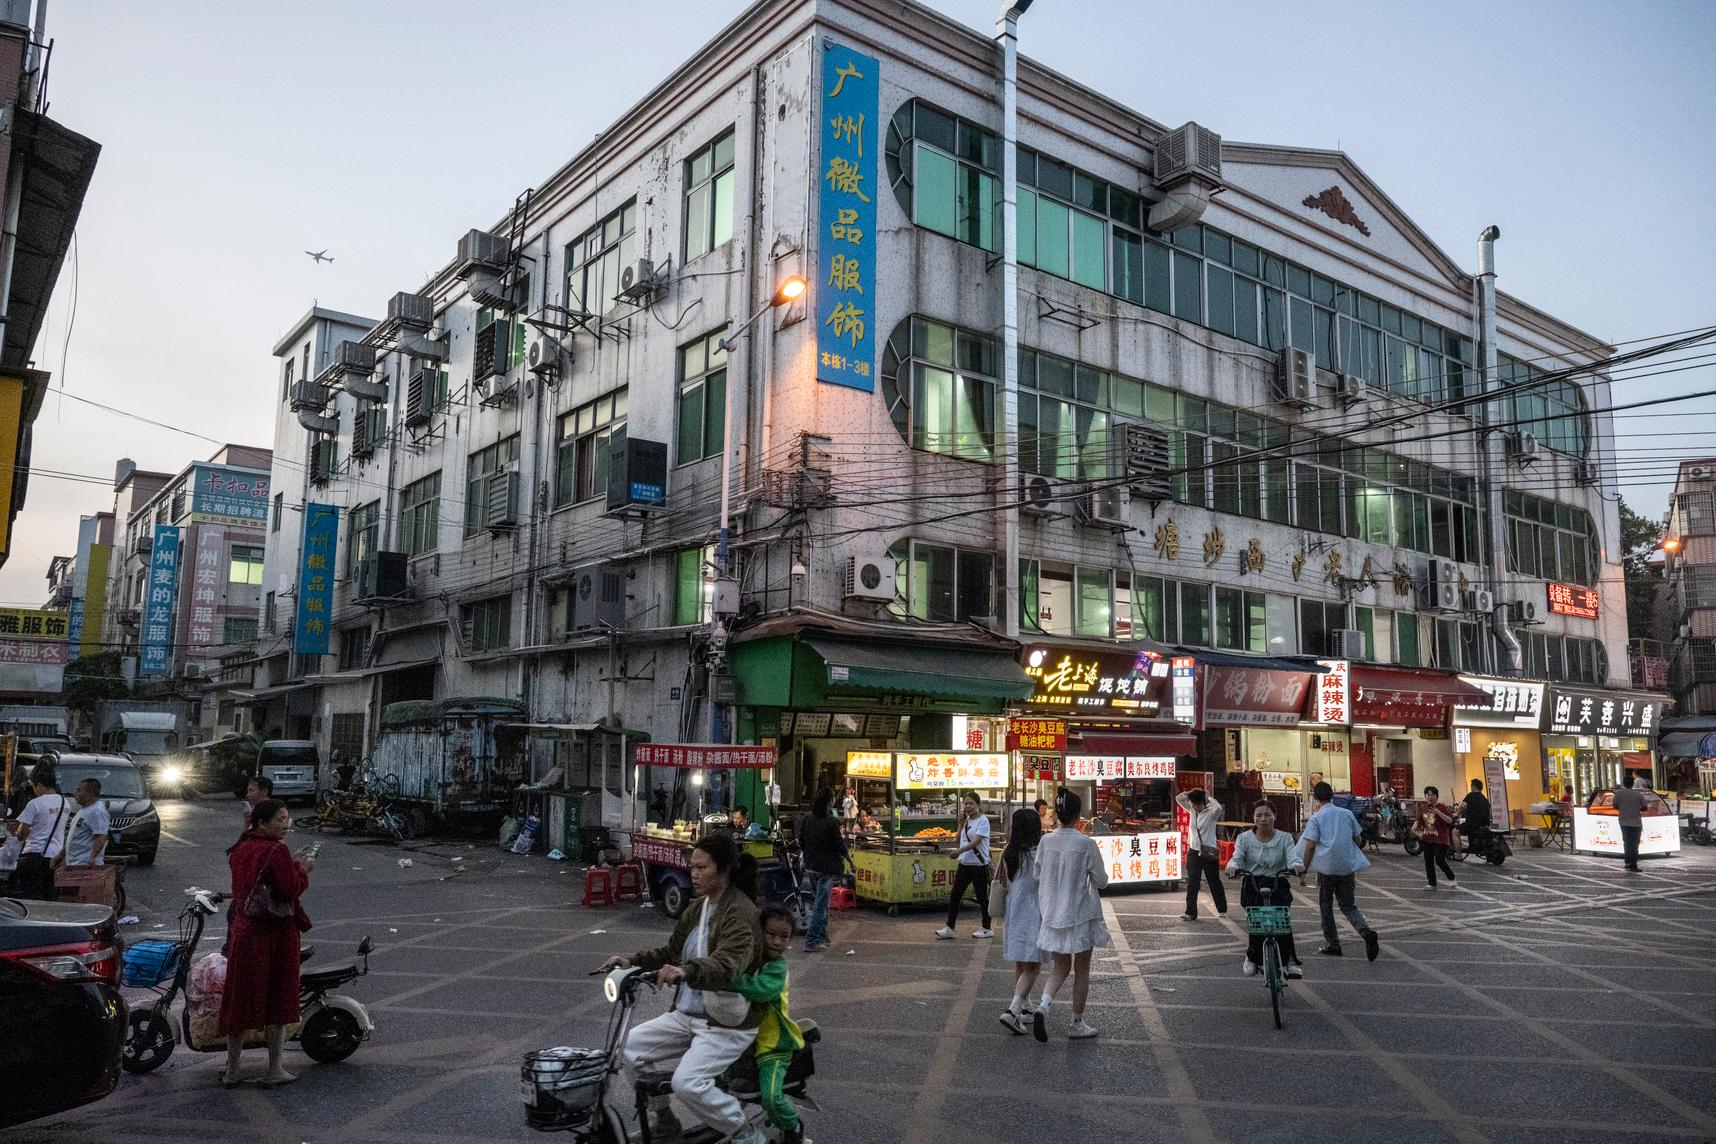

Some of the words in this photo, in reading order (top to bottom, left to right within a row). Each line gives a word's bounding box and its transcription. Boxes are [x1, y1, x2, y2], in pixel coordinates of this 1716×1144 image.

[201, 501, 269, 519] 长期招聘流
[147, 531, 178, 660] 广州麦的龙服饰
[192, 530, 221, 642] 广州宏坤服饰
[1322, 673, 1345, 723] 麻辣烫
[1580, 697, 1653, 728] 芙蓉兴盛
[1011, 721, 1065, 735] 老长沙臭豆腐
[967, 728, 984, 750] 糖
[1019, 735, 1055, 748] 糖油粑粑
[1321, 740, 1344, 753] 麻辣烫
[1068, 759, 1123, 777] 老长沙臭豆腐
[1127, 761, 1175, 777] 奥尔良烤鸡腿
[1112, 858, 1178, 880] 良烤鸡腿
